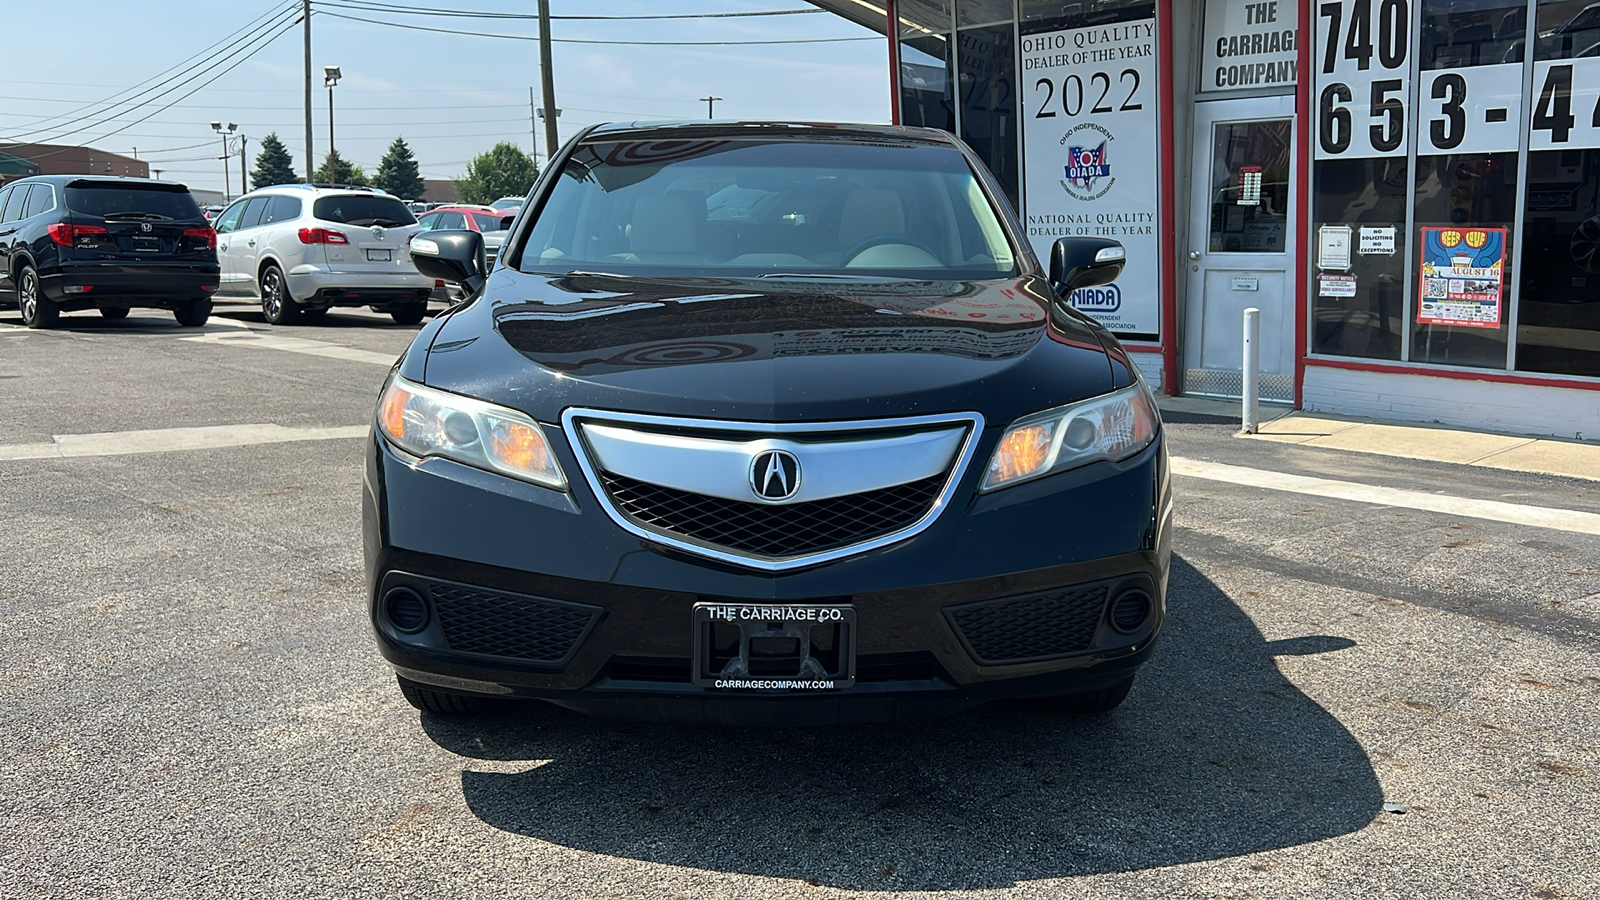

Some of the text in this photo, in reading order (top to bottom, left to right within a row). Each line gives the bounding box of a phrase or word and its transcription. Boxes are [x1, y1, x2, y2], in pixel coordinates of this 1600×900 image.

[1245, 1, 1277, 25] THE
[1022, 23, 1154, 53] OHIO QUALITY
[1320, 0, 1408, 74] 740
[1025, 53, 1070, 70] DEALER
[1072, 52, 1088, 65] OF
[1091, 48, 1116, 63] THE
[1118, 44, 1152, 59] YEAR
[1215, 60, 1298, 88] COMPANY
[1035, 68, 1142, 119] 2022
[1060, 122, 1115, 146] OHIO INDEPENDENT
[1070, 165, 1102, 178] OIADA
[1028, 213, 1154, 225] NATIONAL QUALITY
[1030, 226, 1152, 236] DEALER OF THE YEAR
[1451, 267, 1487, 276] AUGUST
[1072, 288, 1115, 307] NIADA
[707, 606, 844, 621] THE CARRIAGE CO.
[714, 679, 834, 689] CARRIAGECOMPANY.COM
